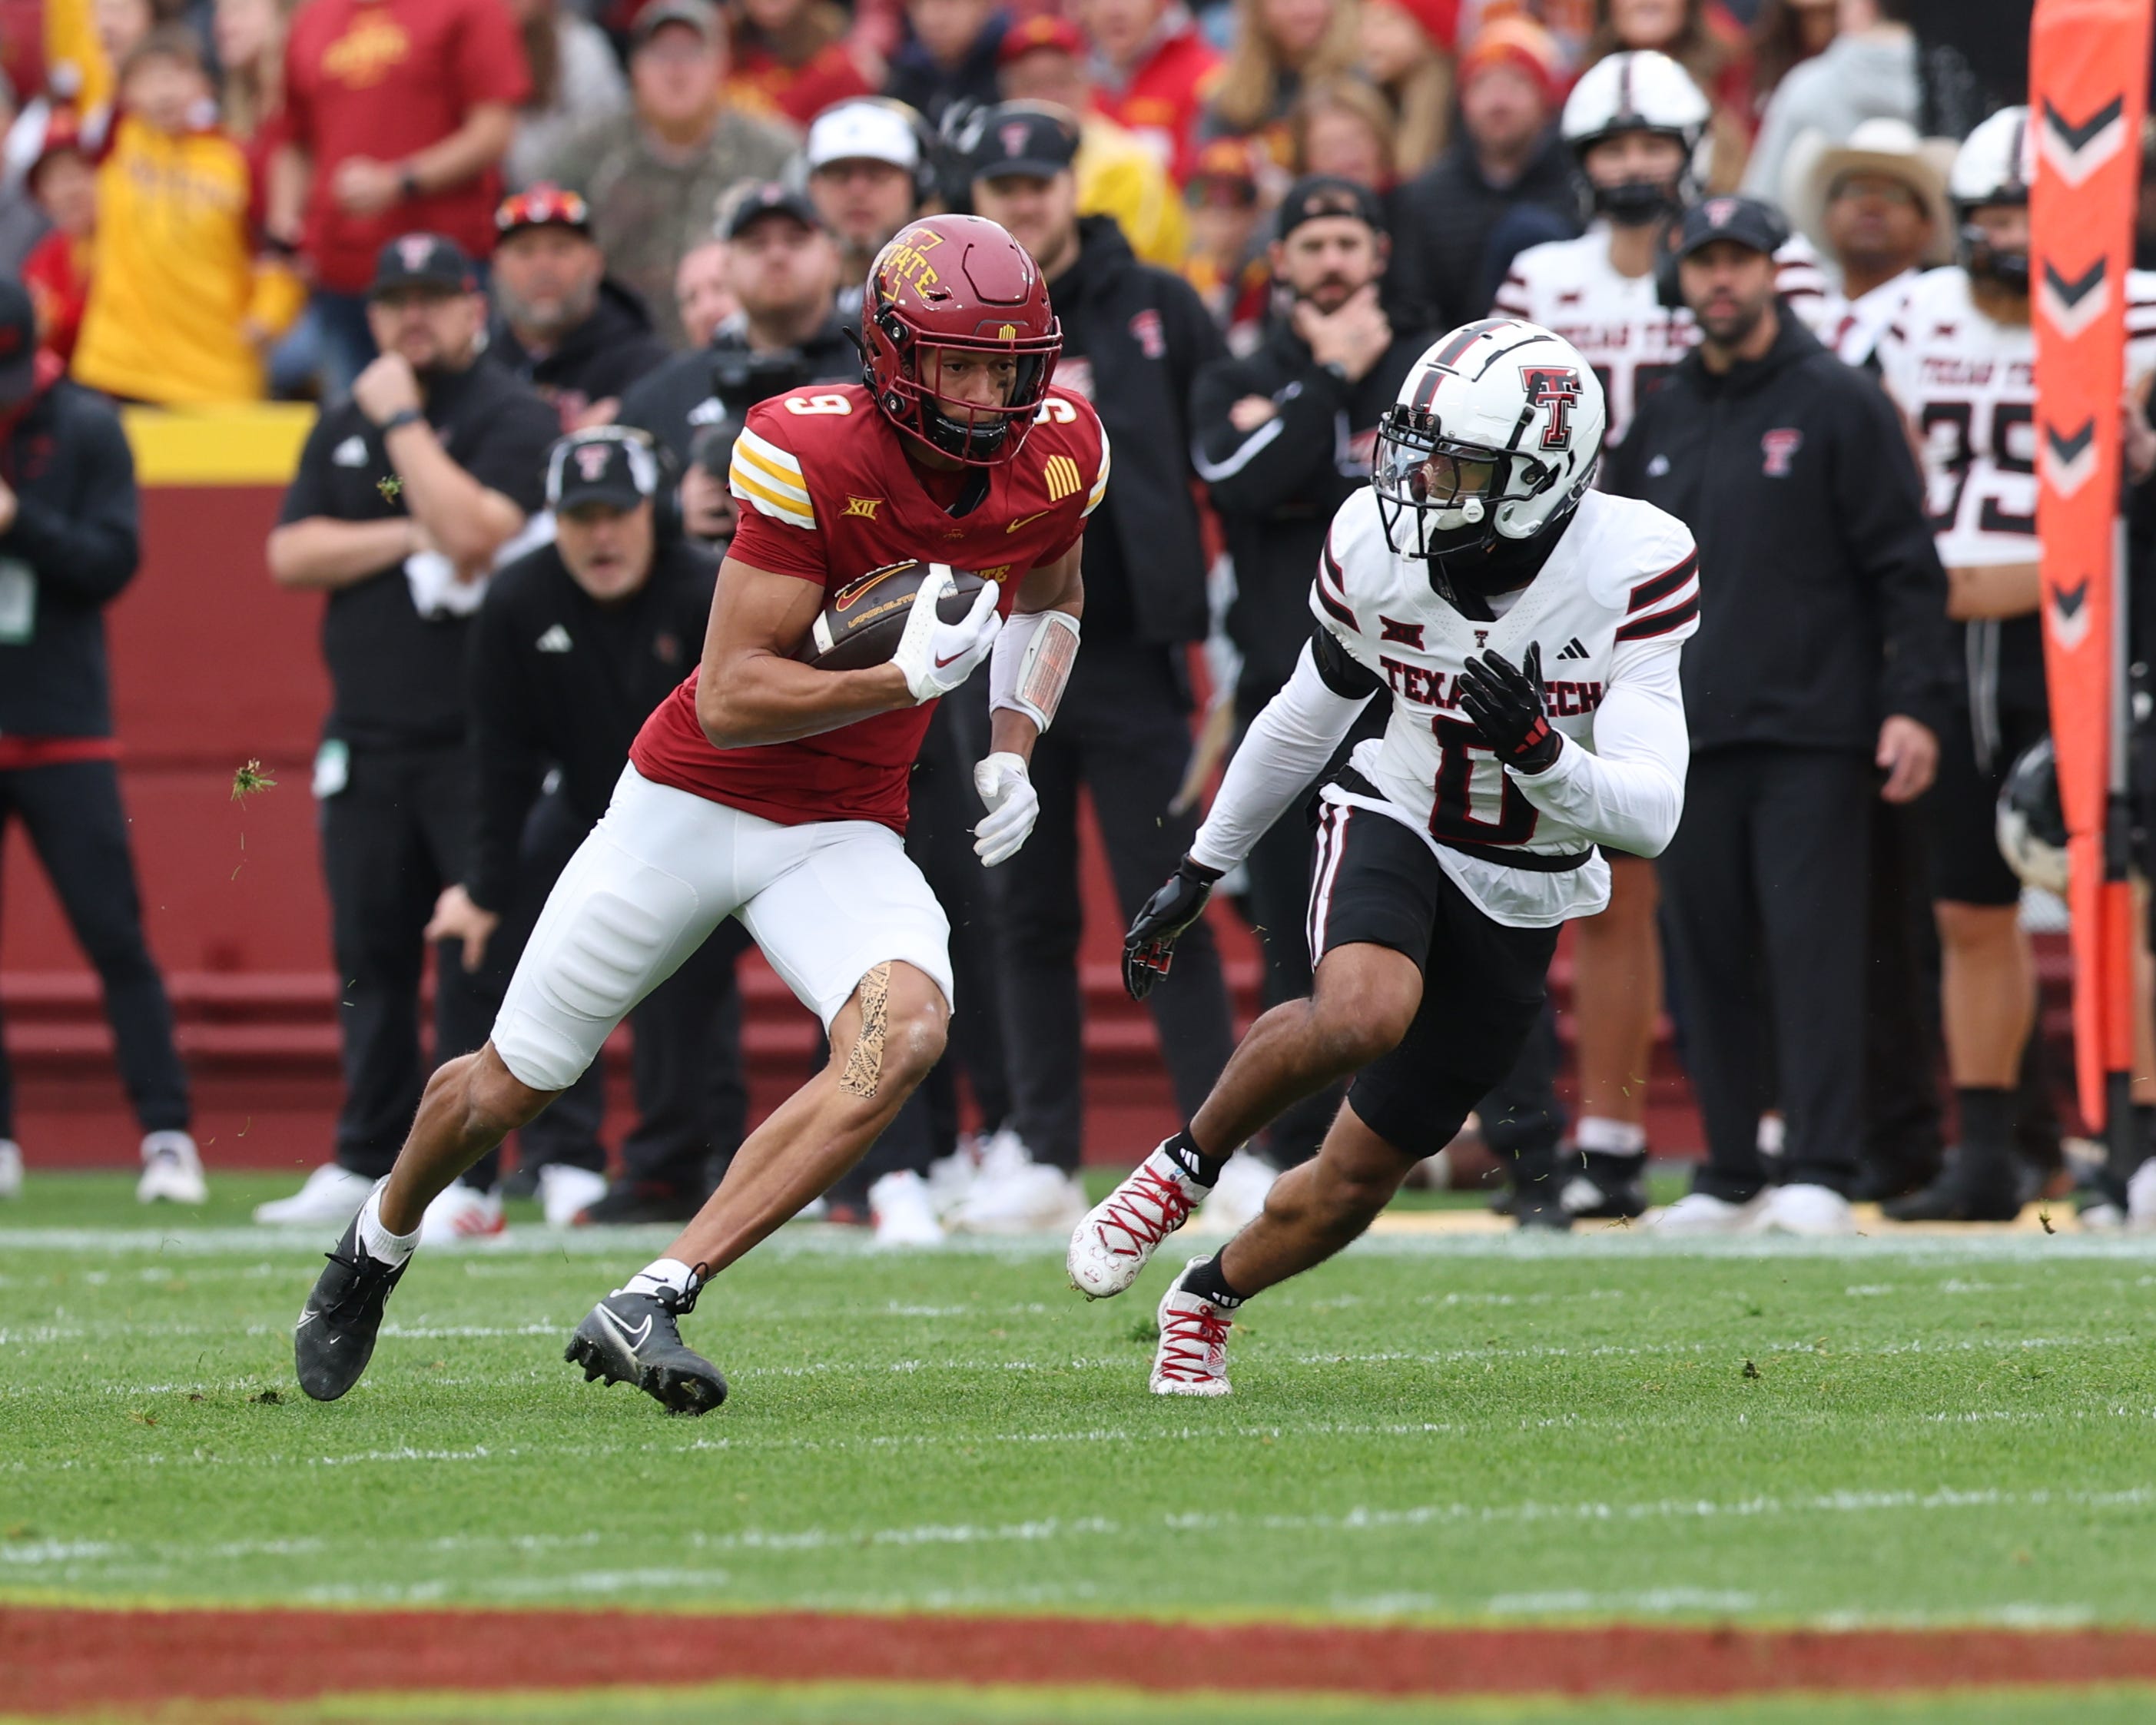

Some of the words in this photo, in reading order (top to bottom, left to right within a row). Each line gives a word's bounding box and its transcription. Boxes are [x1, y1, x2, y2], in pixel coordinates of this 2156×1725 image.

[784, 394, 852, 416] 9
[841, 496, 882, 521] XII
[1379, 654, 1463, 711] TEXA
[1542, 680, 1602, 718] ECH
[1428, 713, 1539, 845] 0
